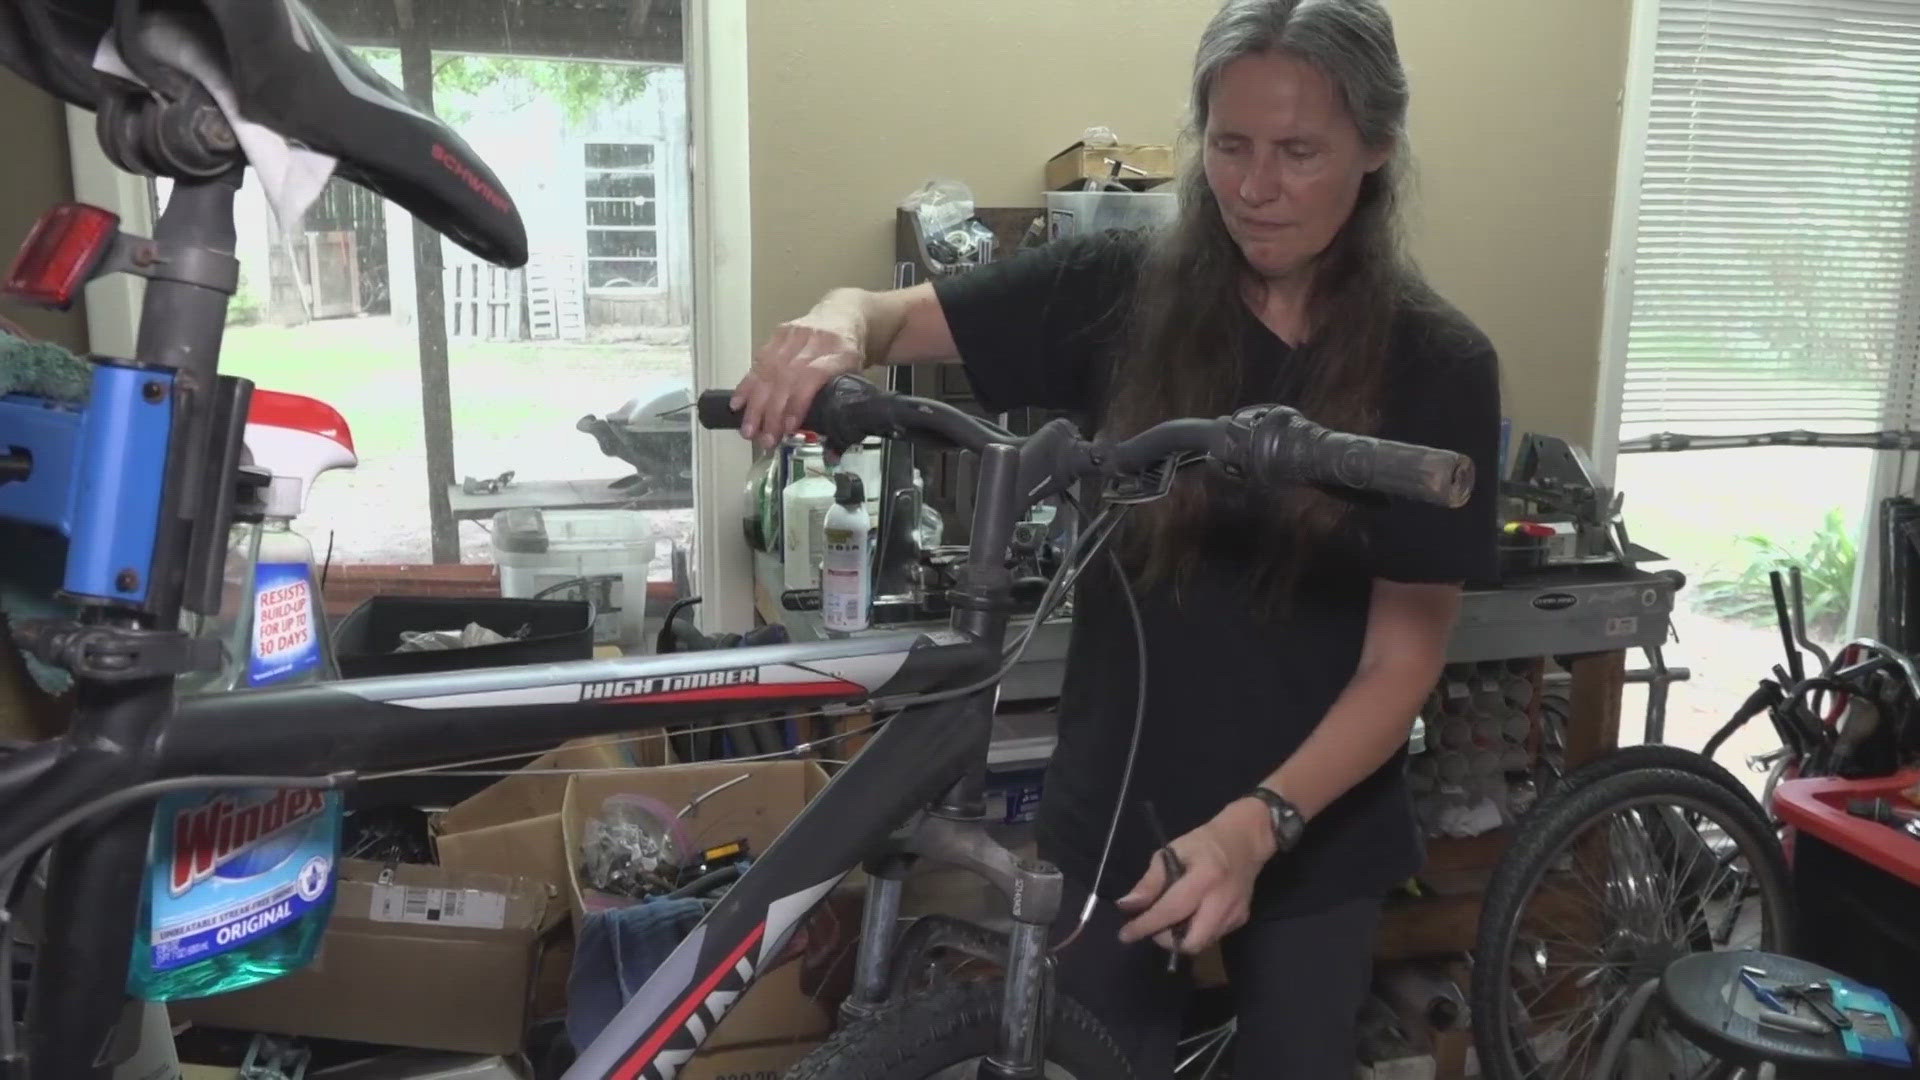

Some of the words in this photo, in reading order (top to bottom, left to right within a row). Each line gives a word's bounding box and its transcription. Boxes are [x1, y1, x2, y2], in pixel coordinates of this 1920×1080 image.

[260, 582, 306, 607] RESISTS
[261, 598, 306, 622] BUILD-UP
[260, 622, 279, 638] FOR
[282, 618, 294, 633] UP
[296, 613, 306, 628] TO
[260, 640, 275, 657] 30
[278, 628, 308, 651] DAYS
[171, 784, 325, 895] Windex
[216, 901, 292, 945] ORIGINAL
